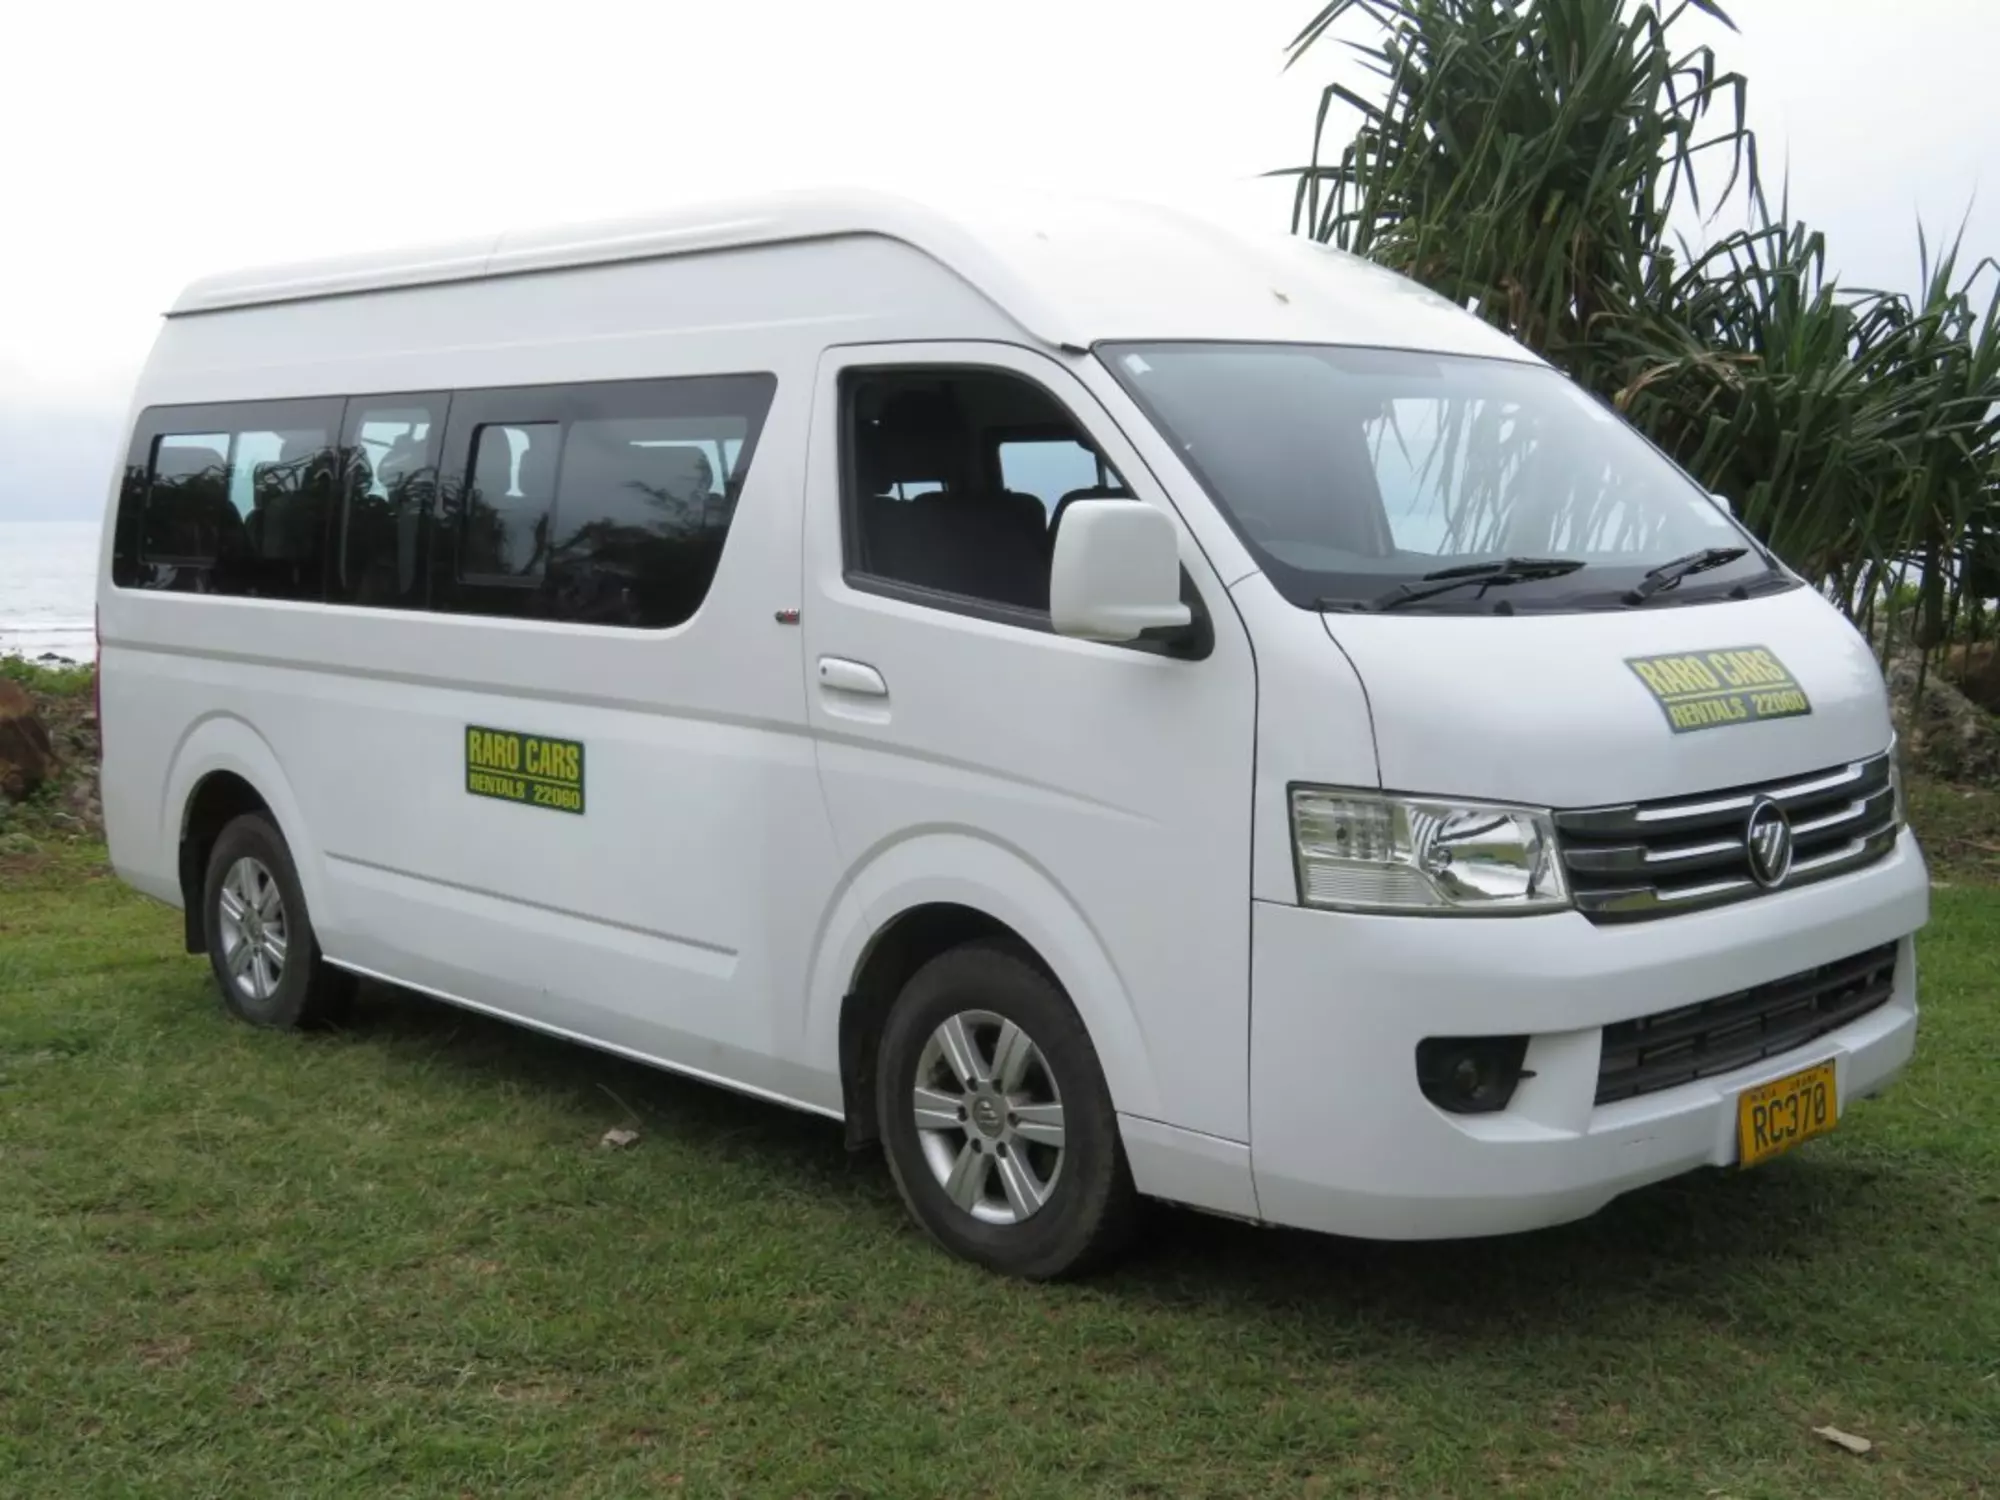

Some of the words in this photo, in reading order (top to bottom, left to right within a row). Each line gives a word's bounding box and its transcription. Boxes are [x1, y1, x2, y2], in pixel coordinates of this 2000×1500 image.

[1632, 656, 1721, 695] RARO
[1707, 650, 1787, 686] CARS
[1669, 698, 1748, 727] RENTALS
[469, 729, 519, 770] RARO
[525, 738, 579, 780] CARS
[469, 772, 525, 799] RENTALS
[1752, 1081, 1826, 1153] RC370
